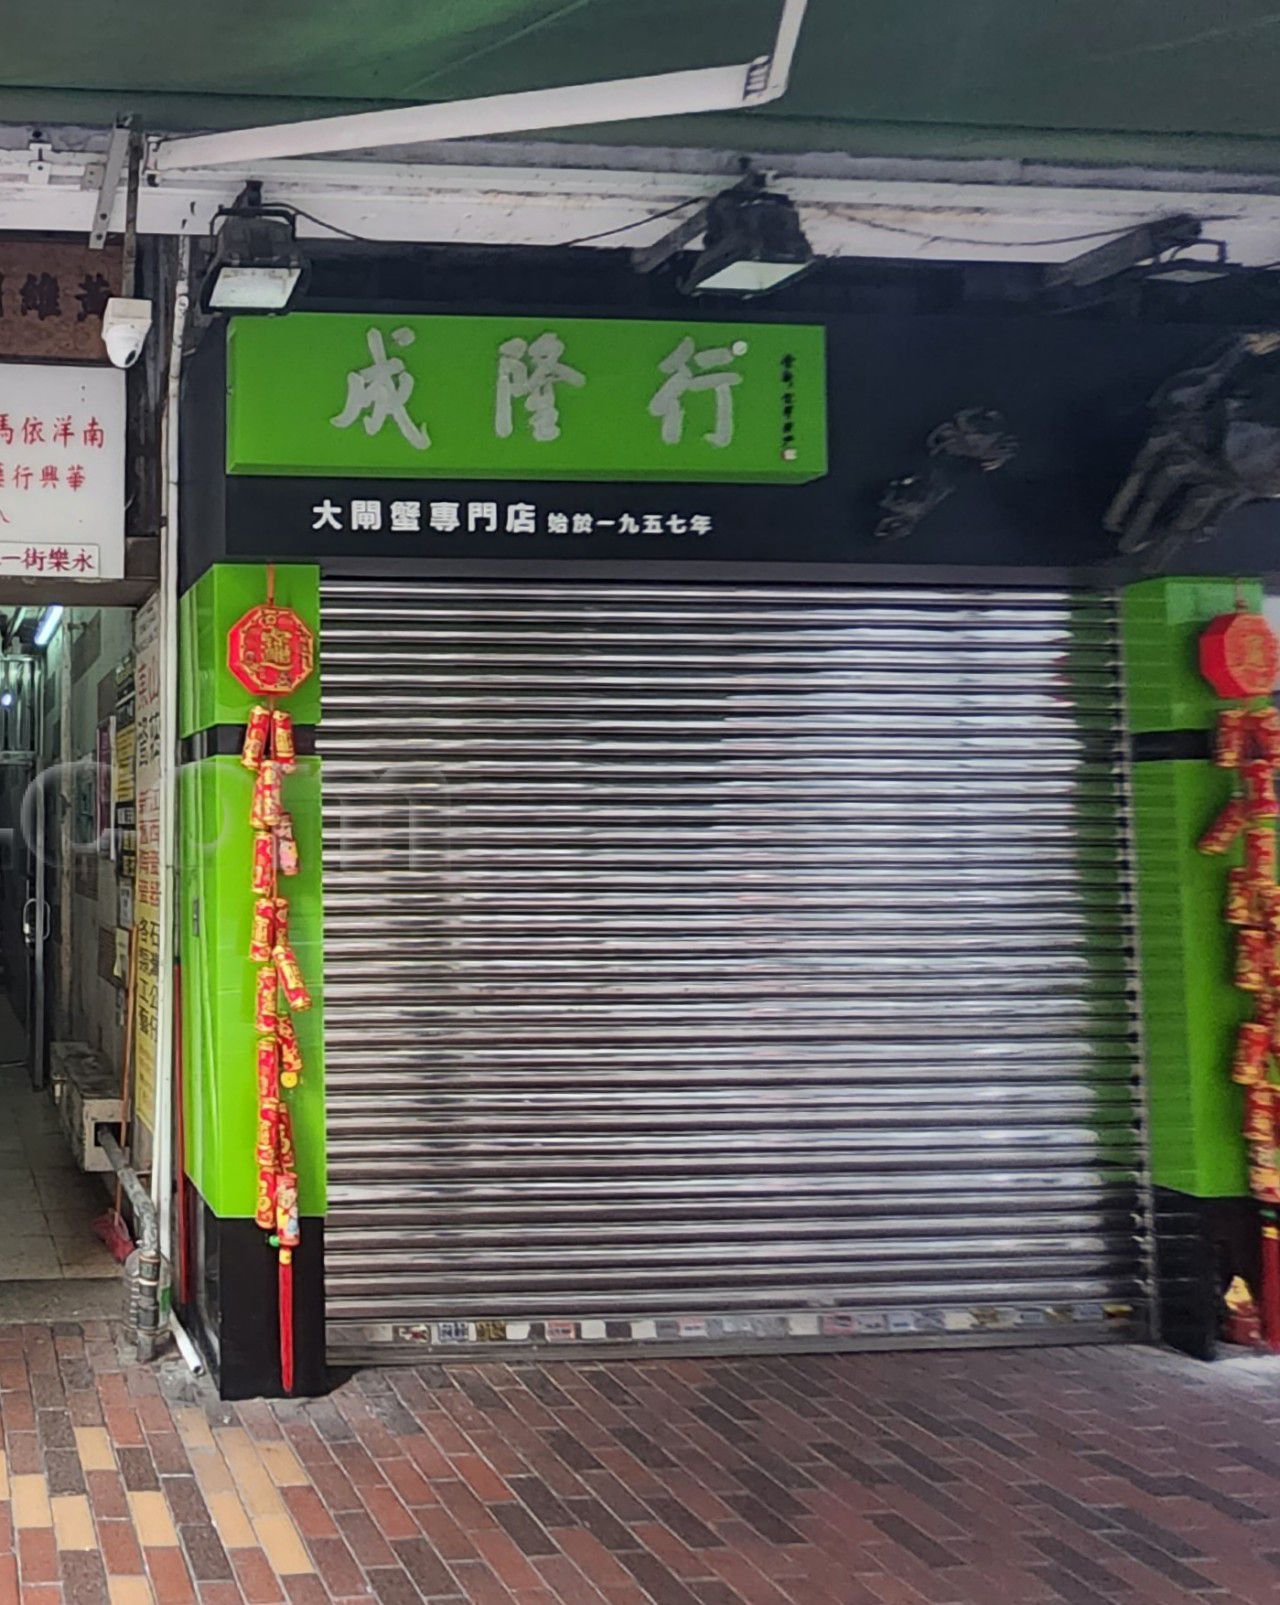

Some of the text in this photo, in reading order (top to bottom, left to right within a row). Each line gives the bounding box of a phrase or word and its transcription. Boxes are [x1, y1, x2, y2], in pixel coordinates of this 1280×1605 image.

[330, 326, 743, 449] 成隆行
[312, 499, 713, 536] 大閘蟹專門店 始於一九五七年
